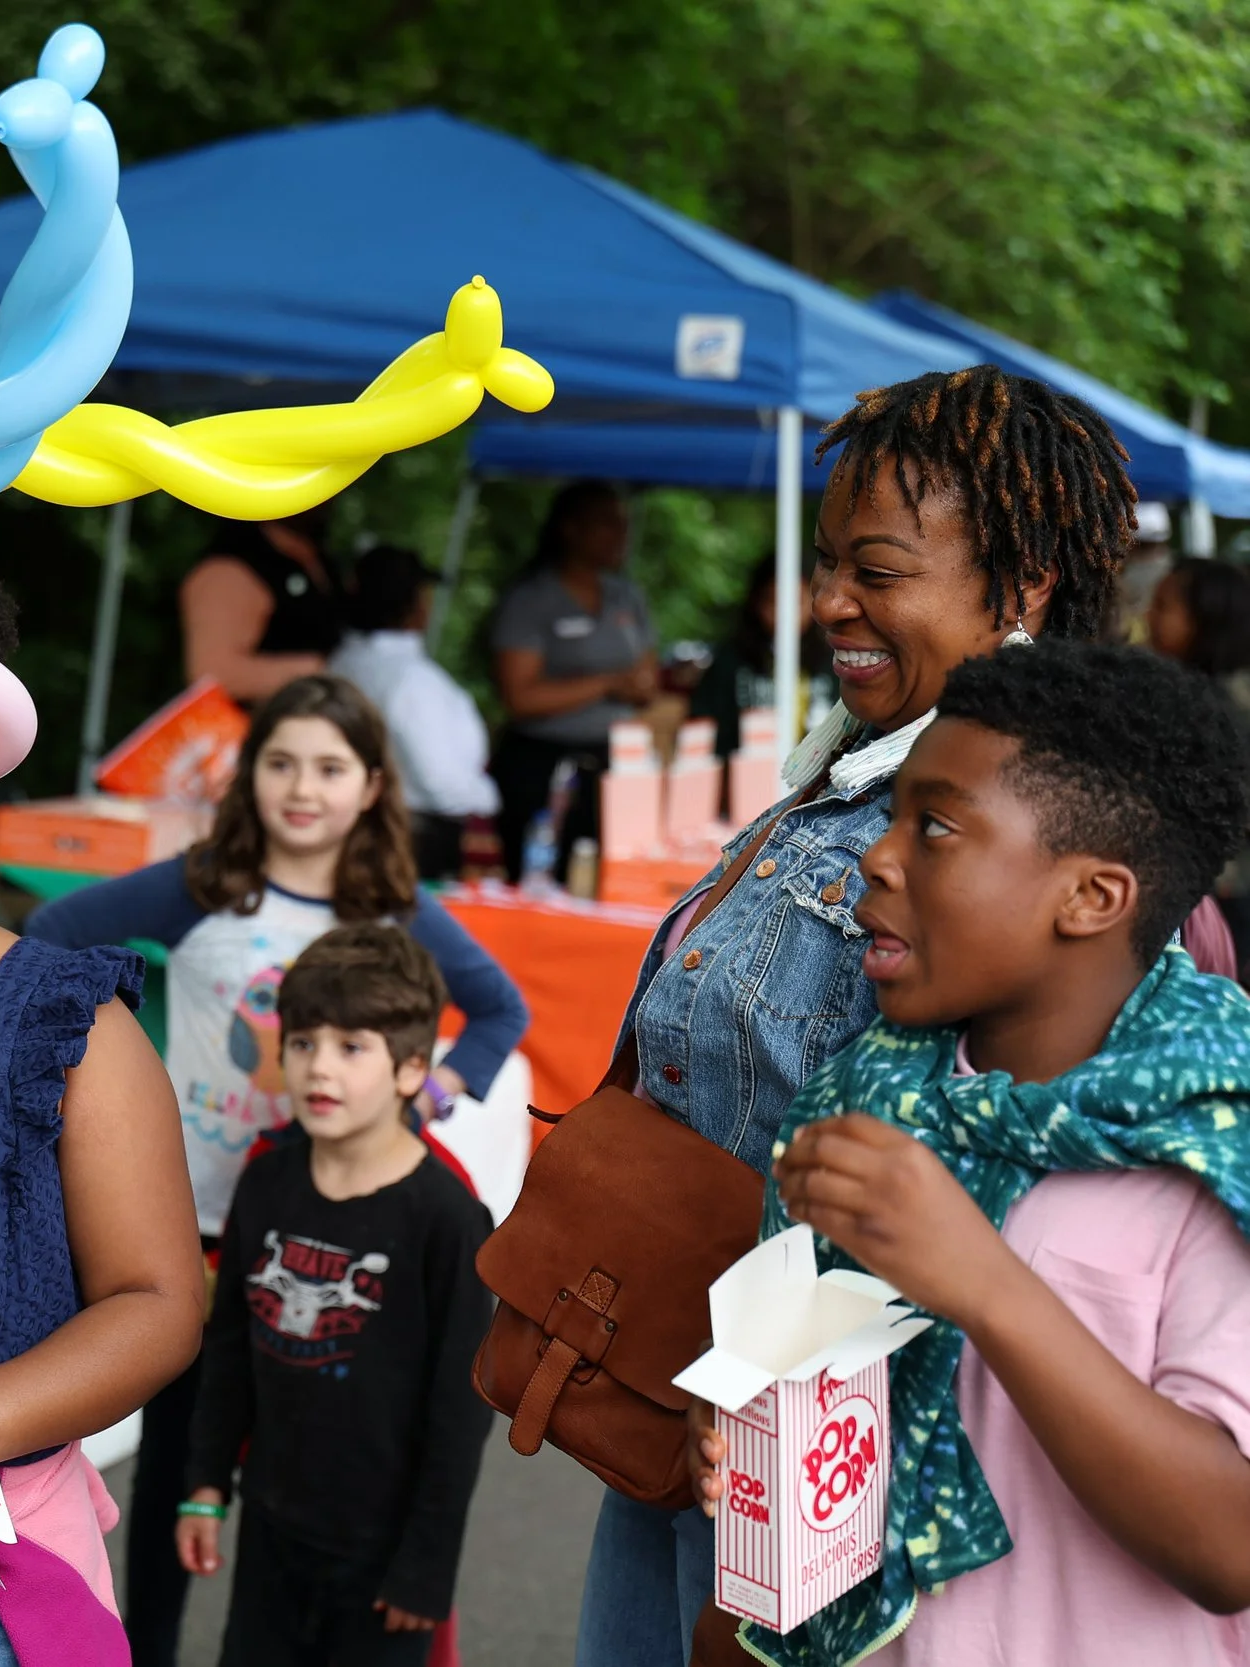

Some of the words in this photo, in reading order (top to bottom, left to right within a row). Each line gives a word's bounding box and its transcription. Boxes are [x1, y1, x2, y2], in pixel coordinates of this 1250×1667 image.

[805, 1415, 858, 1488] POP
[812, 1426, 877, 1522] CORN
[728, 1470, 765, 1500] POP
[727, 1493, 769, 1525] CORN
[802, 1531, 856, 1586] DELICIOUS
[851, 1541, 881, 1577] CRISP
